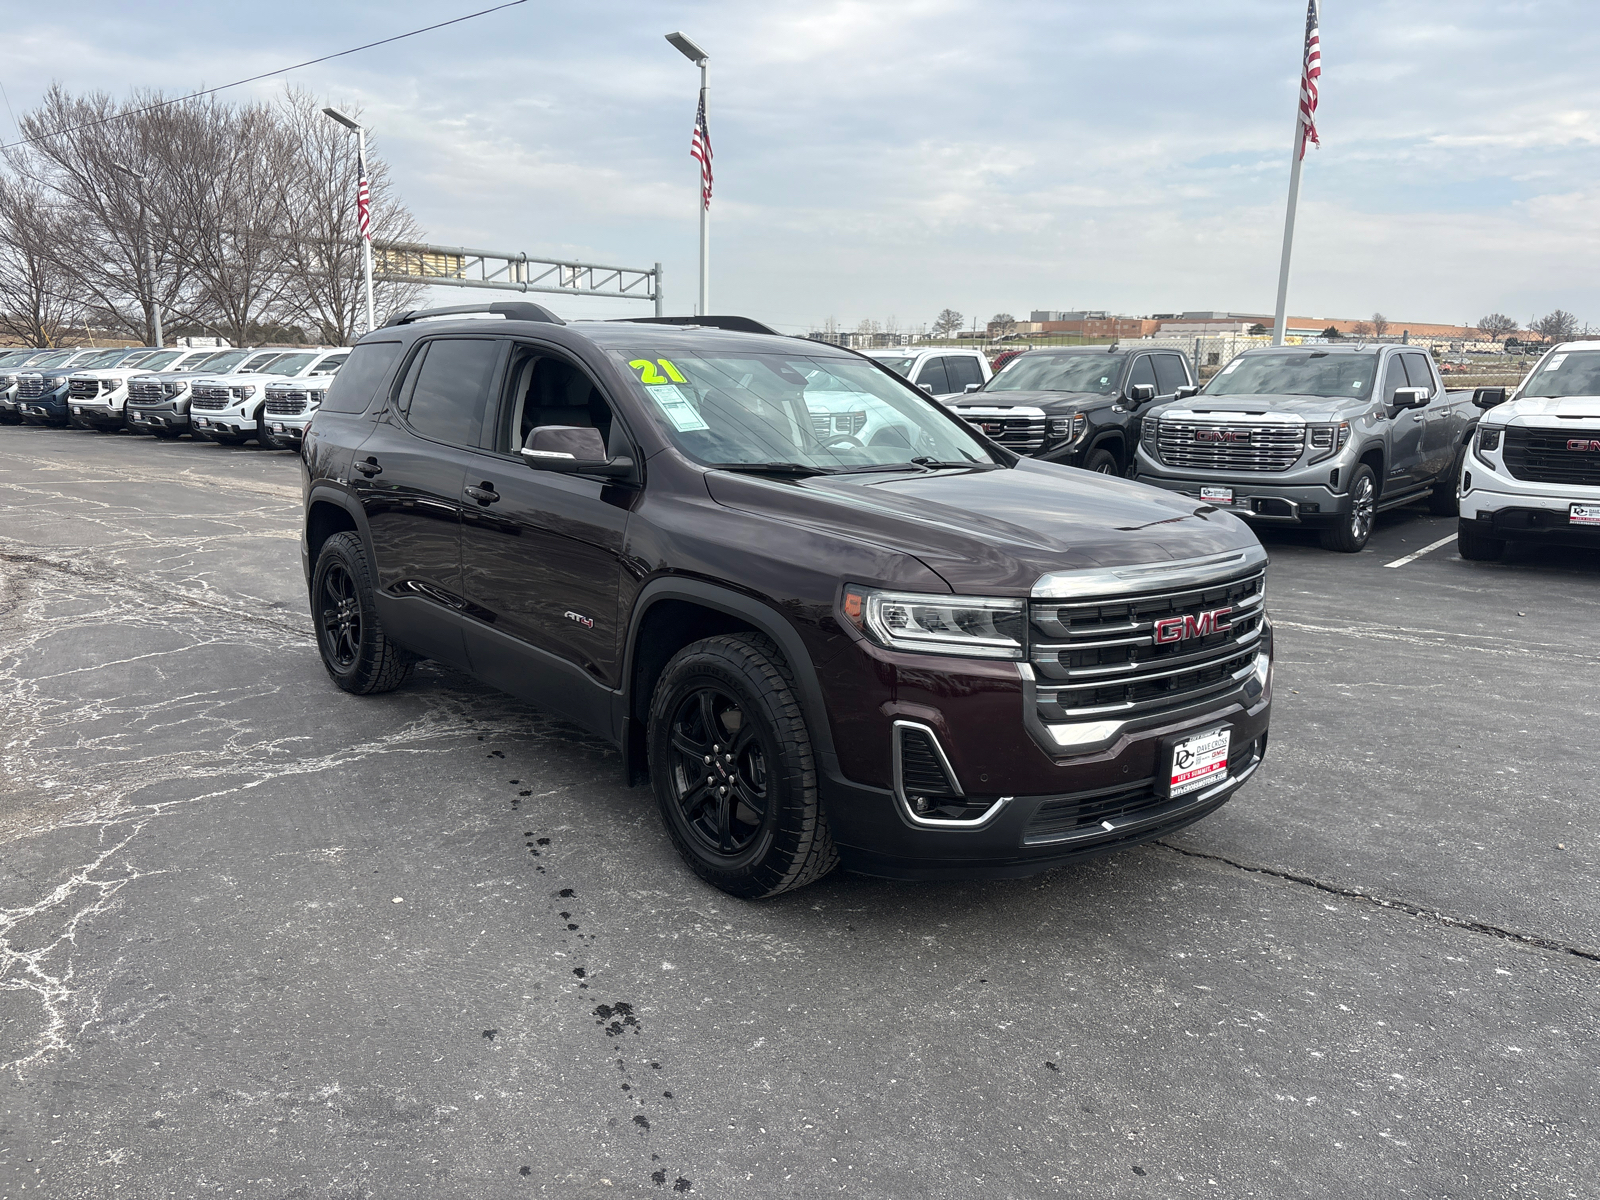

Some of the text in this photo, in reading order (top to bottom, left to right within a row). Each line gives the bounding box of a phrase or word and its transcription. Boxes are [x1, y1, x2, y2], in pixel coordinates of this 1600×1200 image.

[629, 359, 687, 384] 21
[1196, 430, 1250, 442] GMC
[564, 611, 593, 628] AT4
[1153, 607, 1233, 645] GMC
[1196, 737, 1228, 753] DAVE CROSS
[1211, 748, 1226, 758] GMC
[1177, 762, 1220, 782] LEE'S SUMMIT, MO
